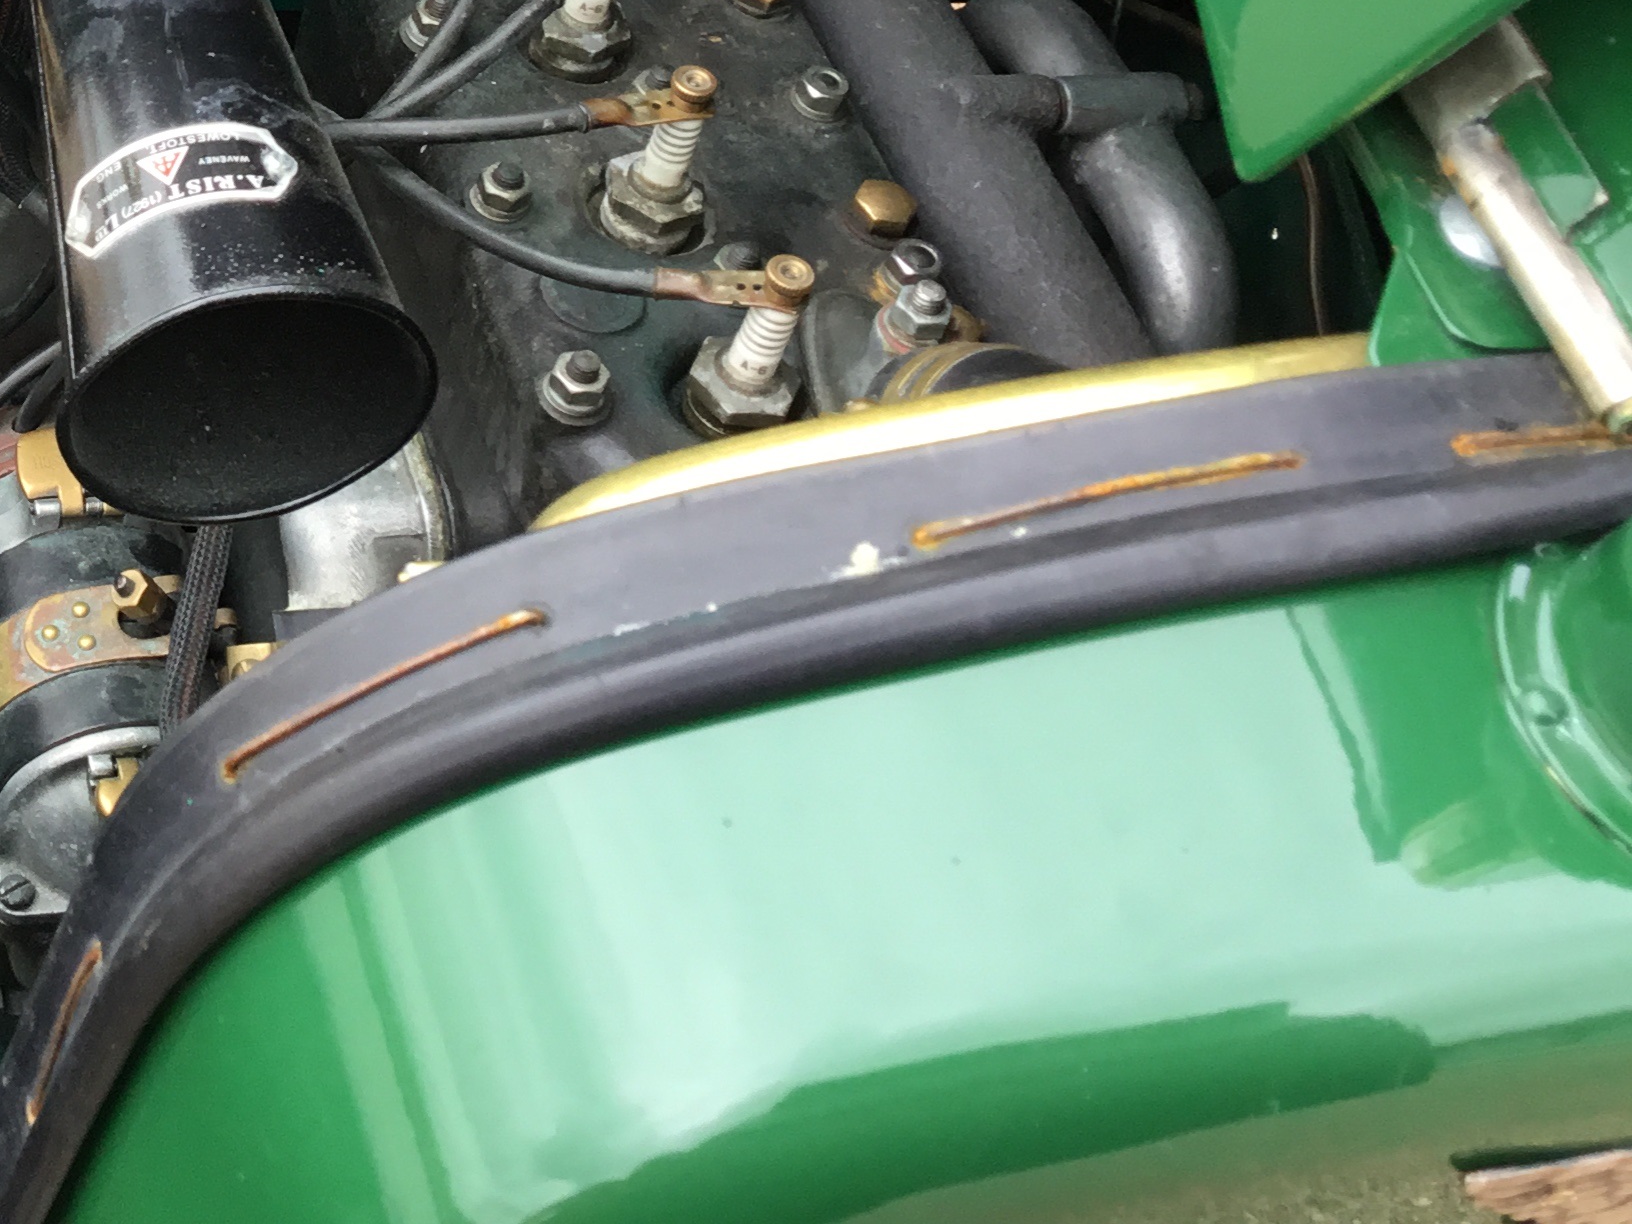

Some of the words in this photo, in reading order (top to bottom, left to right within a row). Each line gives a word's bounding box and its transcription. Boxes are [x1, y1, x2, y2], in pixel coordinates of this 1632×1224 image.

[197, 154, 251, 166] WAVENEY
[95, 183, 129, 210] WORKS
[120, 190, 163, 216] (1927)
